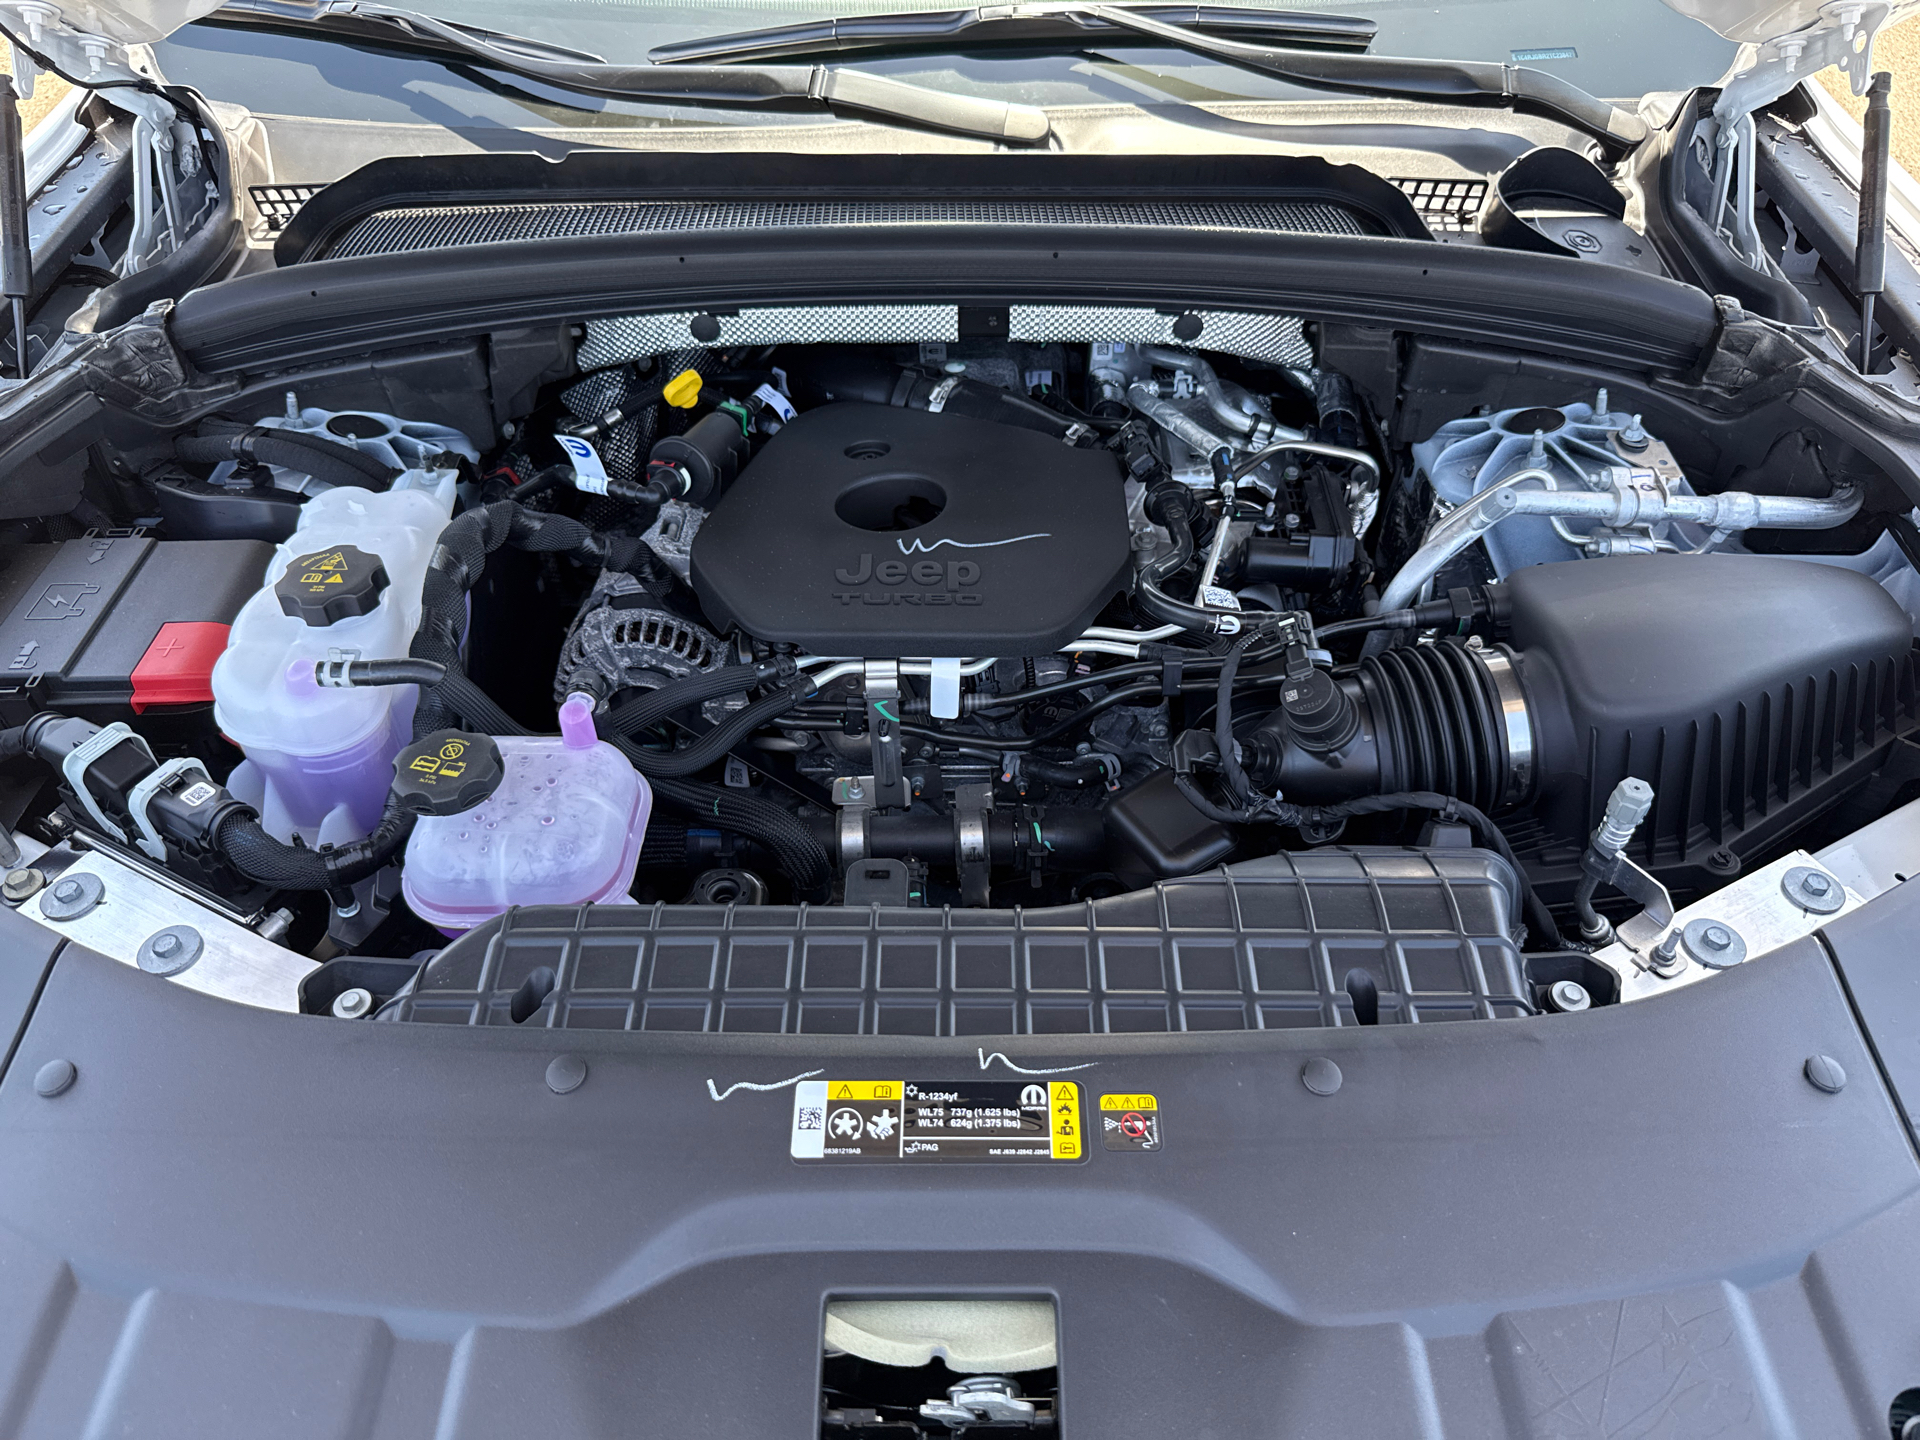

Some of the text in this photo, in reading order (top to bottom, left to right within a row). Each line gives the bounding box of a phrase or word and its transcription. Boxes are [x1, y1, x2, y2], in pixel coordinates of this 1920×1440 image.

[834, 553, 981, 592] Jeep
[831, 592, 983, 606] TURBO
[918, 1092, 958, 1102] R-1234yf
[918, 1108, 1021, 1118] WL75 737g (1.625 lbs)
[918, 1118, 1021, 1129] WL74 624g (1.375 lbs)
[921, 1143, 938, 1151] PAG
